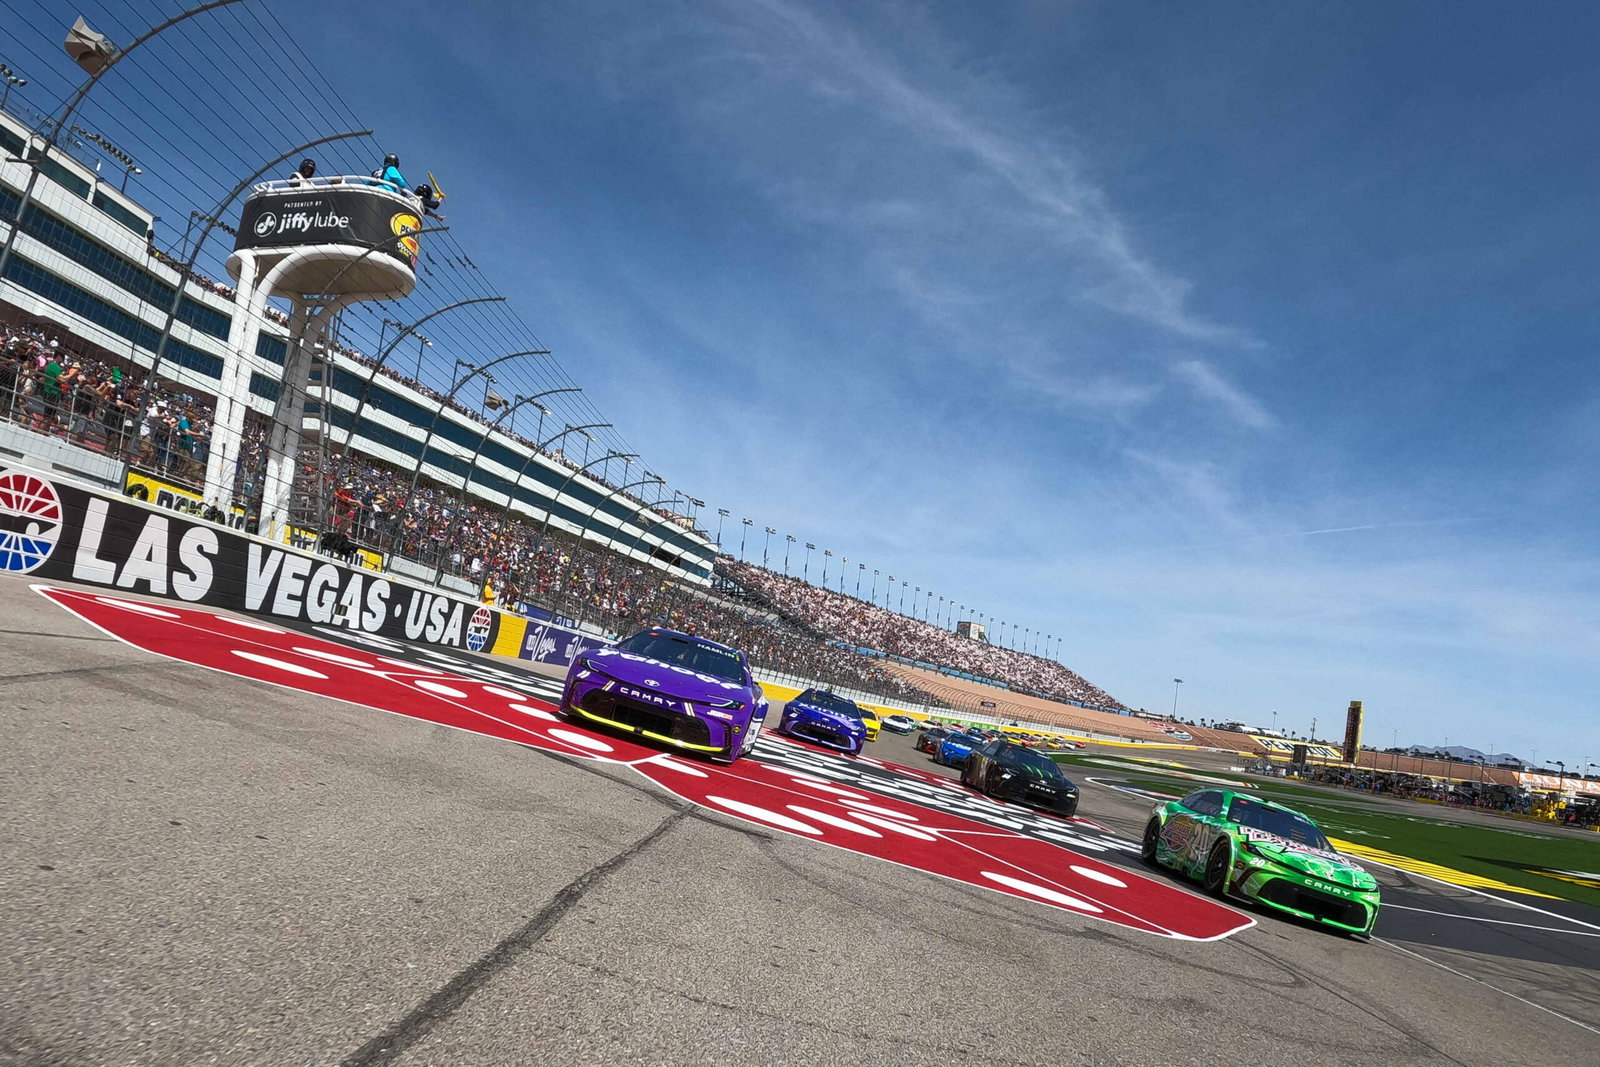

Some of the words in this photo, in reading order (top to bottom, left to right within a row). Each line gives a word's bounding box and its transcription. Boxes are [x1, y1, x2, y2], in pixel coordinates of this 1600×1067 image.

[277, 212, 314, 234] jiffy
[314, 211, 349, 228] lube
[72, 498, 219, 602] LAS
[244, 543, 391, 633] VEGAS
[405, 590, 464, 647] USA
[697, 643, 735, 658] HAMLIN
[620, 686, 676, 707] CAMRY
[811, 721, 837, 731] CAMRY
[1029, 783, 1056, 794] CAMRY
[1191, 822, 1210, 850] 20
[1249, 857, 1265, 867] 20
[1304, 879, 1351, 897] CAMRY
